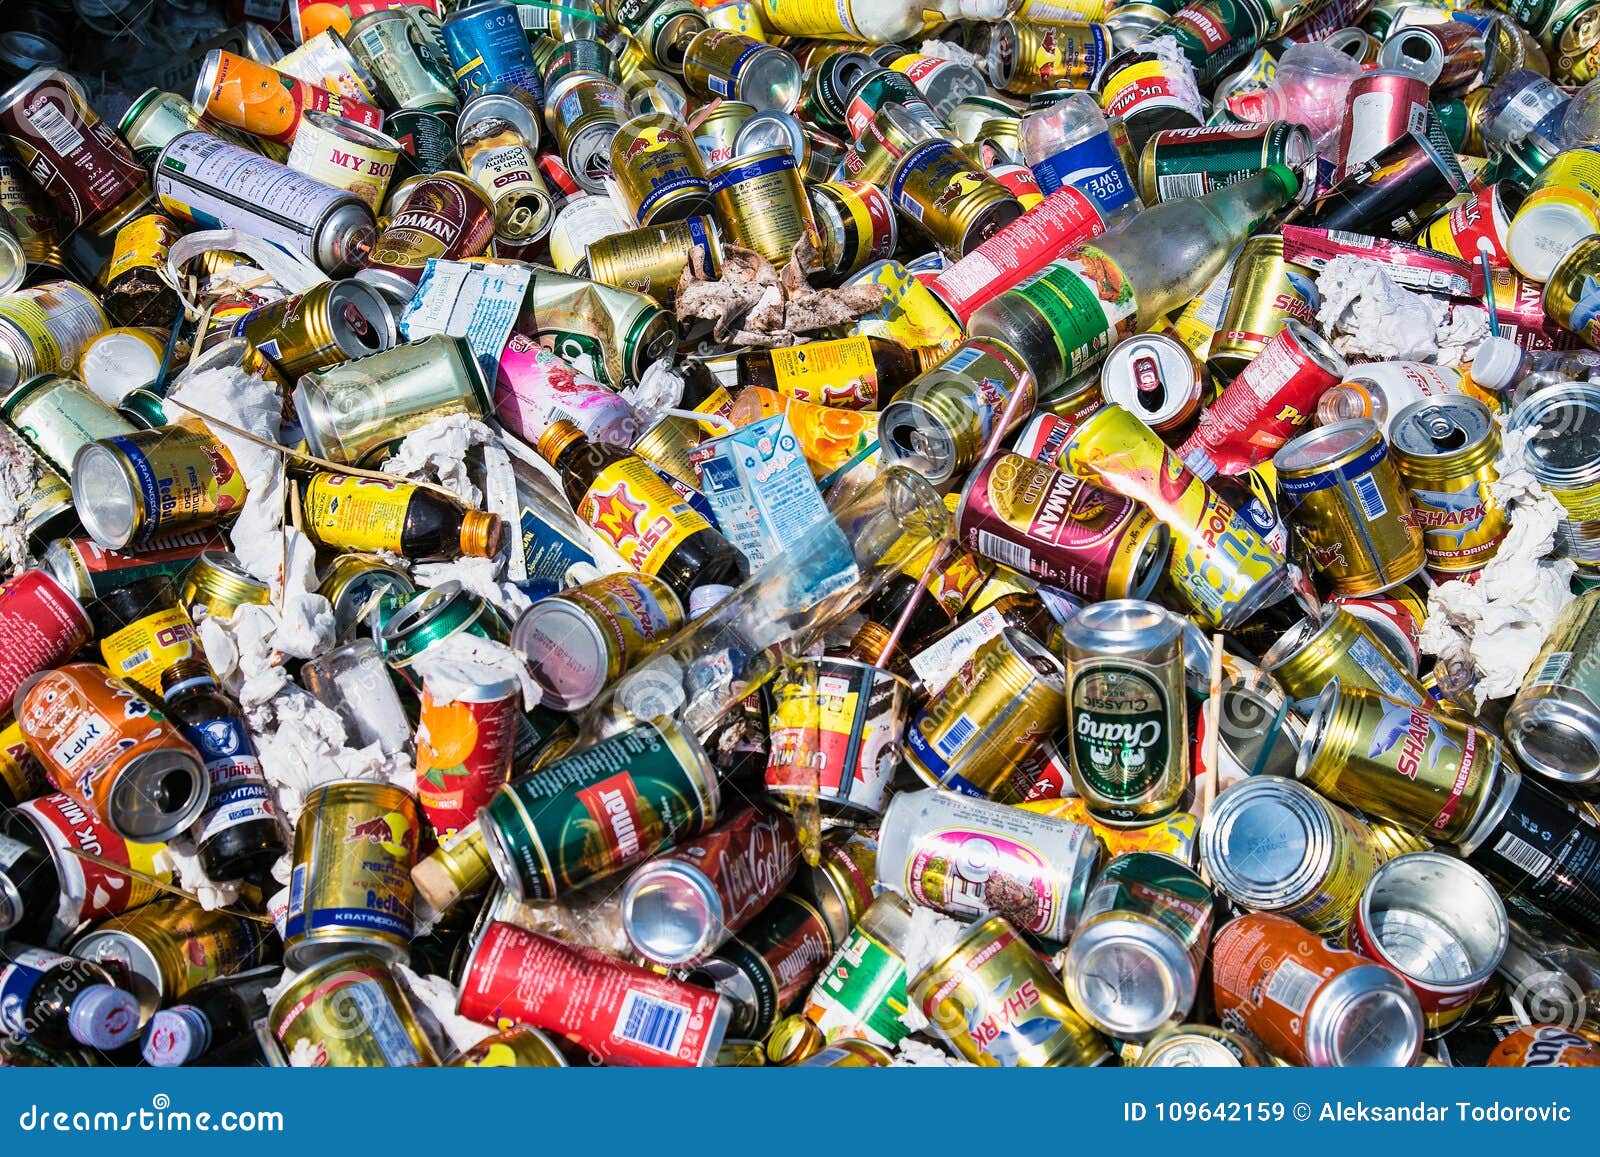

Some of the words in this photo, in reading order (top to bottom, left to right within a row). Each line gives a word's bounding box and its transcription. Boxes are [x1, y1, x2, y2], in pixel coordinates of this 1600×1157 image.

[1142, 84, 1165, 97] UK
[330, 149, 364, 173] MY
[511, 157, 529, 170] Rich
[710, 147, 733, 164] RK
[496, 171, 533, 188] UFC
[1416, 501, 1488, 527] SHARK
[1462, 540, 1496, 556] DRINK
[1082, 695, 1150, 709] CLASSIC
[1077, 712, 1162, 743] Chang
[1397, 707, 1432, 780] SHARK
[1452, 751, 1474, 796] ENERGY
[971, 979, 1042, 1054] SHARK
